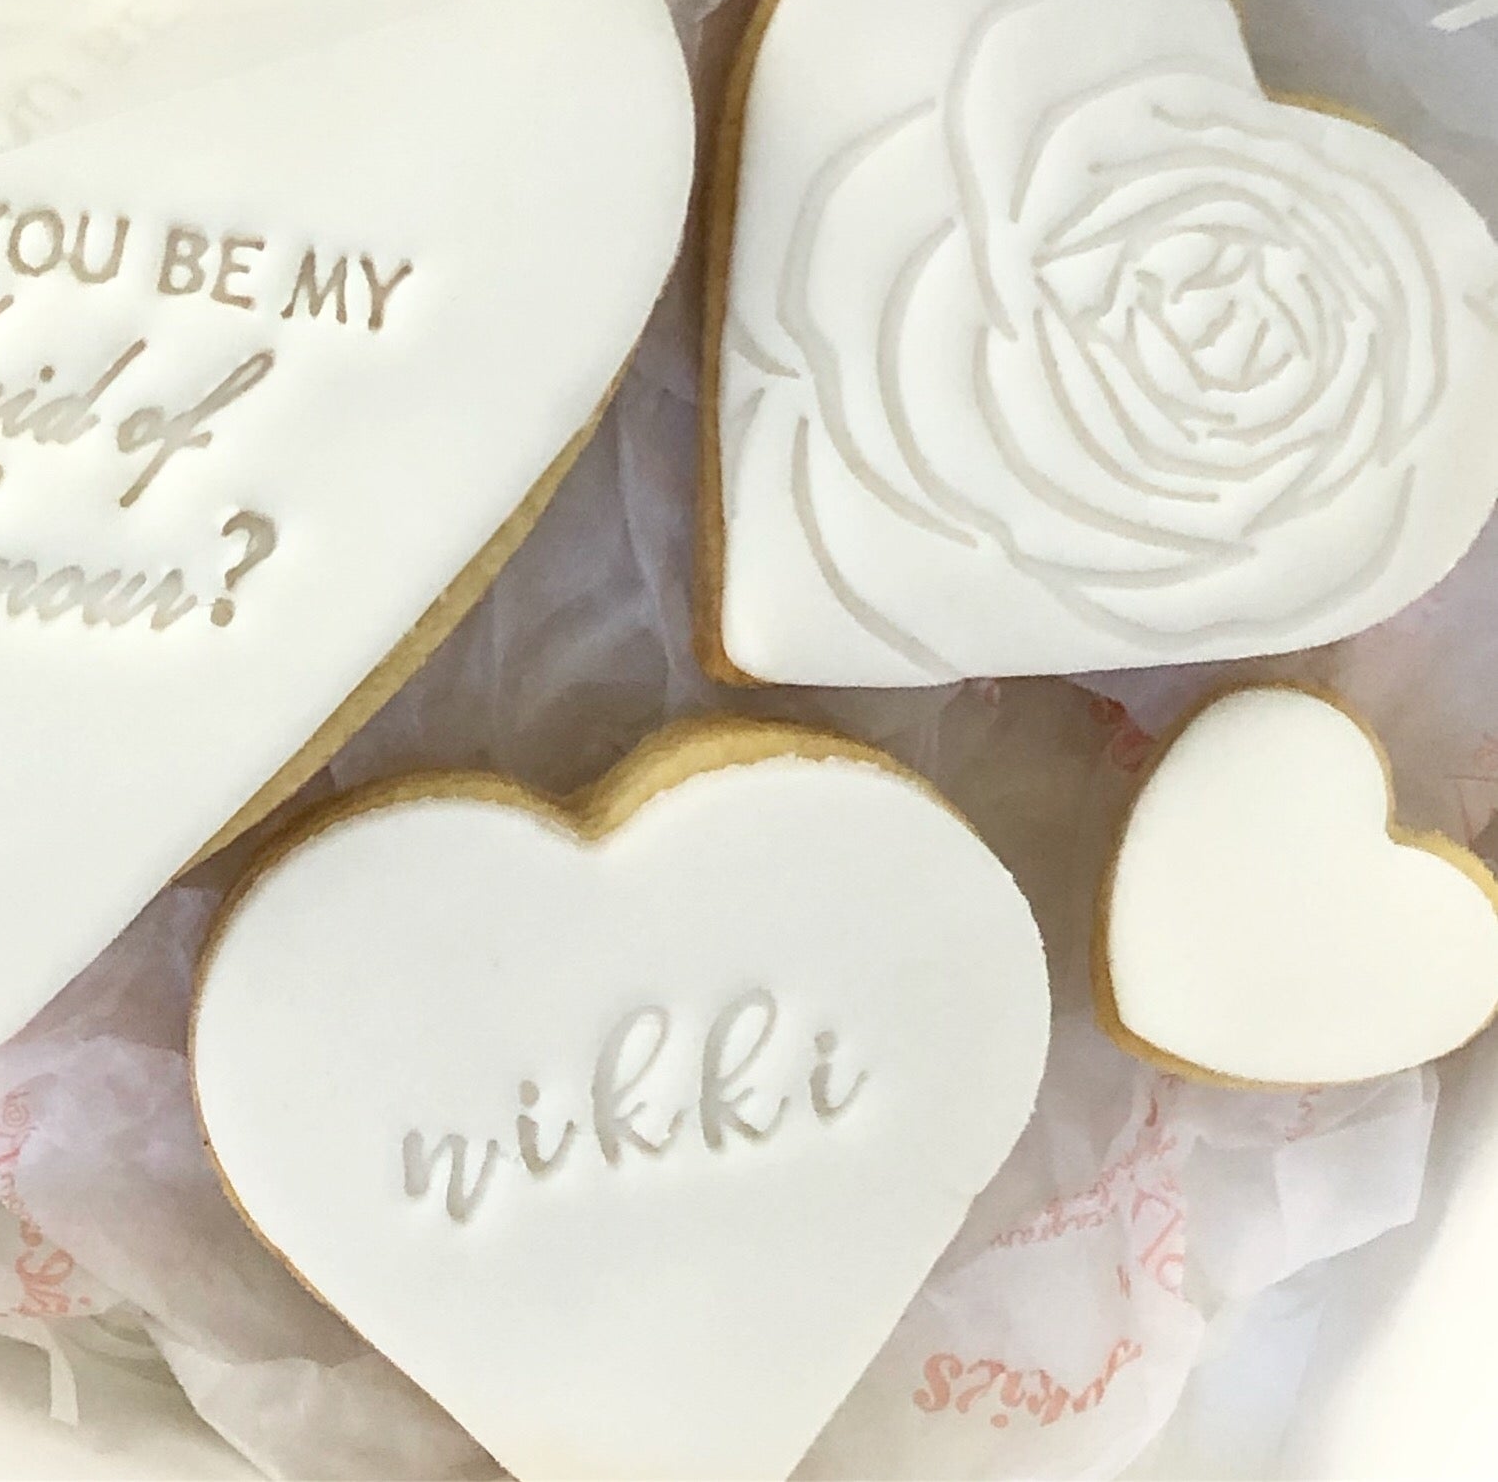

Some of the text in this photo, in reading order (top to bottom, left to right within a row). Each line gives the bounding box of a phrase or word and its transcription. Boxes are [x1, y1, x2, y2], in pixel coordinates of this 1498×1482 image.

[156, 224, 266, 311] BE
[280, 244, 414, 333] MY
[115, 349, 276, 508] of
[402, 986, 870, 1224] nikki
